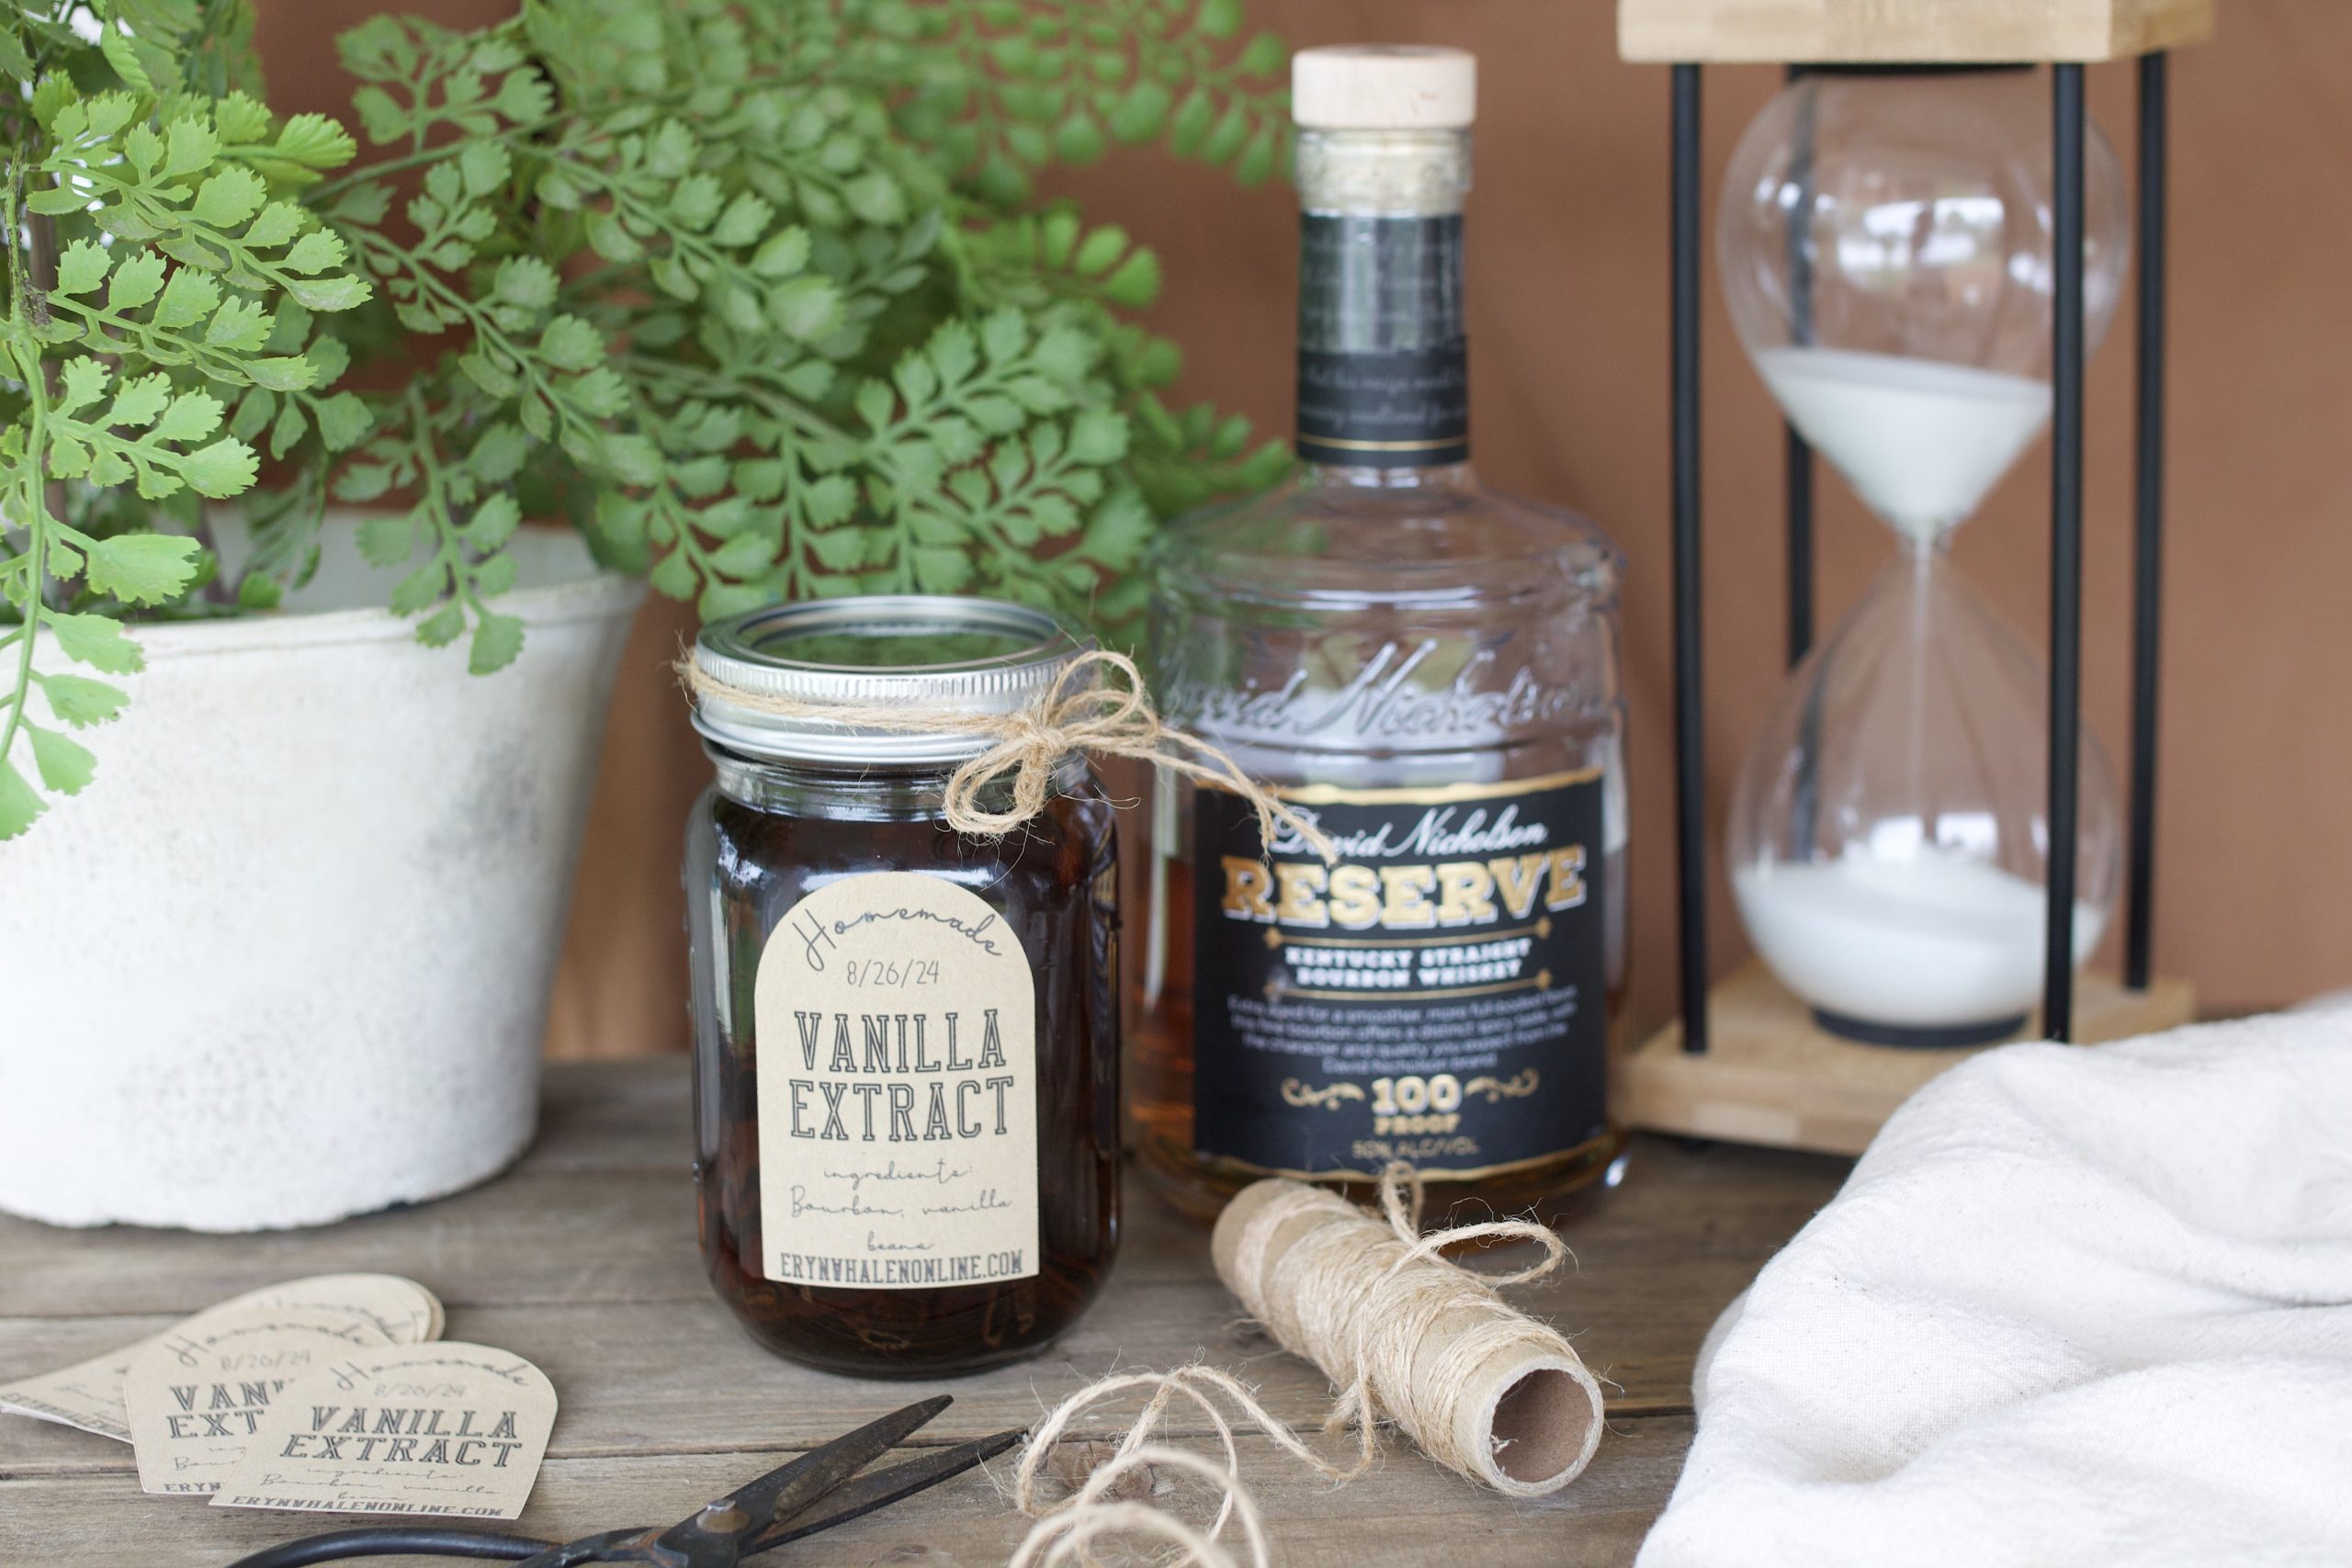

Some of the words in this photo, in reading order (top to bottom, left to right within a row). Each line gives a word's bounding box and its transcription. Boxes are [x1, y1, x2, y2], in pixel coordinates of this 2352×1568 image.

[1381, 803, 1548, 858] Nicholson
[1220, 845, 1588, 931] RESERVE
[792, 908, 1003, 972] Homemade
[1284, 945, 1414, 968] KENTUCKY
[1419, 937, 1532, 967] STRAIGHT
[846, 959, 940, 988] 8/26/24
[1295, 965, 1411, 988] BOURBON
[794, 1009, 1007, 1074] VANILLA
[789, 1076, 1014, 1143] EXTRACT
[1372, 1073, 1463, 1116] 100
[1374, 1112, 1462, 1136] PROOF
[789, 1184, 904, 1218] Bourbon,
[922, 1189, 1012, 1214] vanilla
[866, 1230, 935, 1252] beans
[780, 1249, 1024, 1285] ERYNWHALENONLINE.COM
[329, 1357, 530, 1392] Homemade
[166, 1409, 266, 1439] EXT
[311, 1405, 518, 1439] VANILLA
[279, 1434, 523, 1468] EXTRACT
[164, 1482, 221, 1492] ERYN
[231, 1495, 503, 1517] ERYNWHALENONLINE.COM
